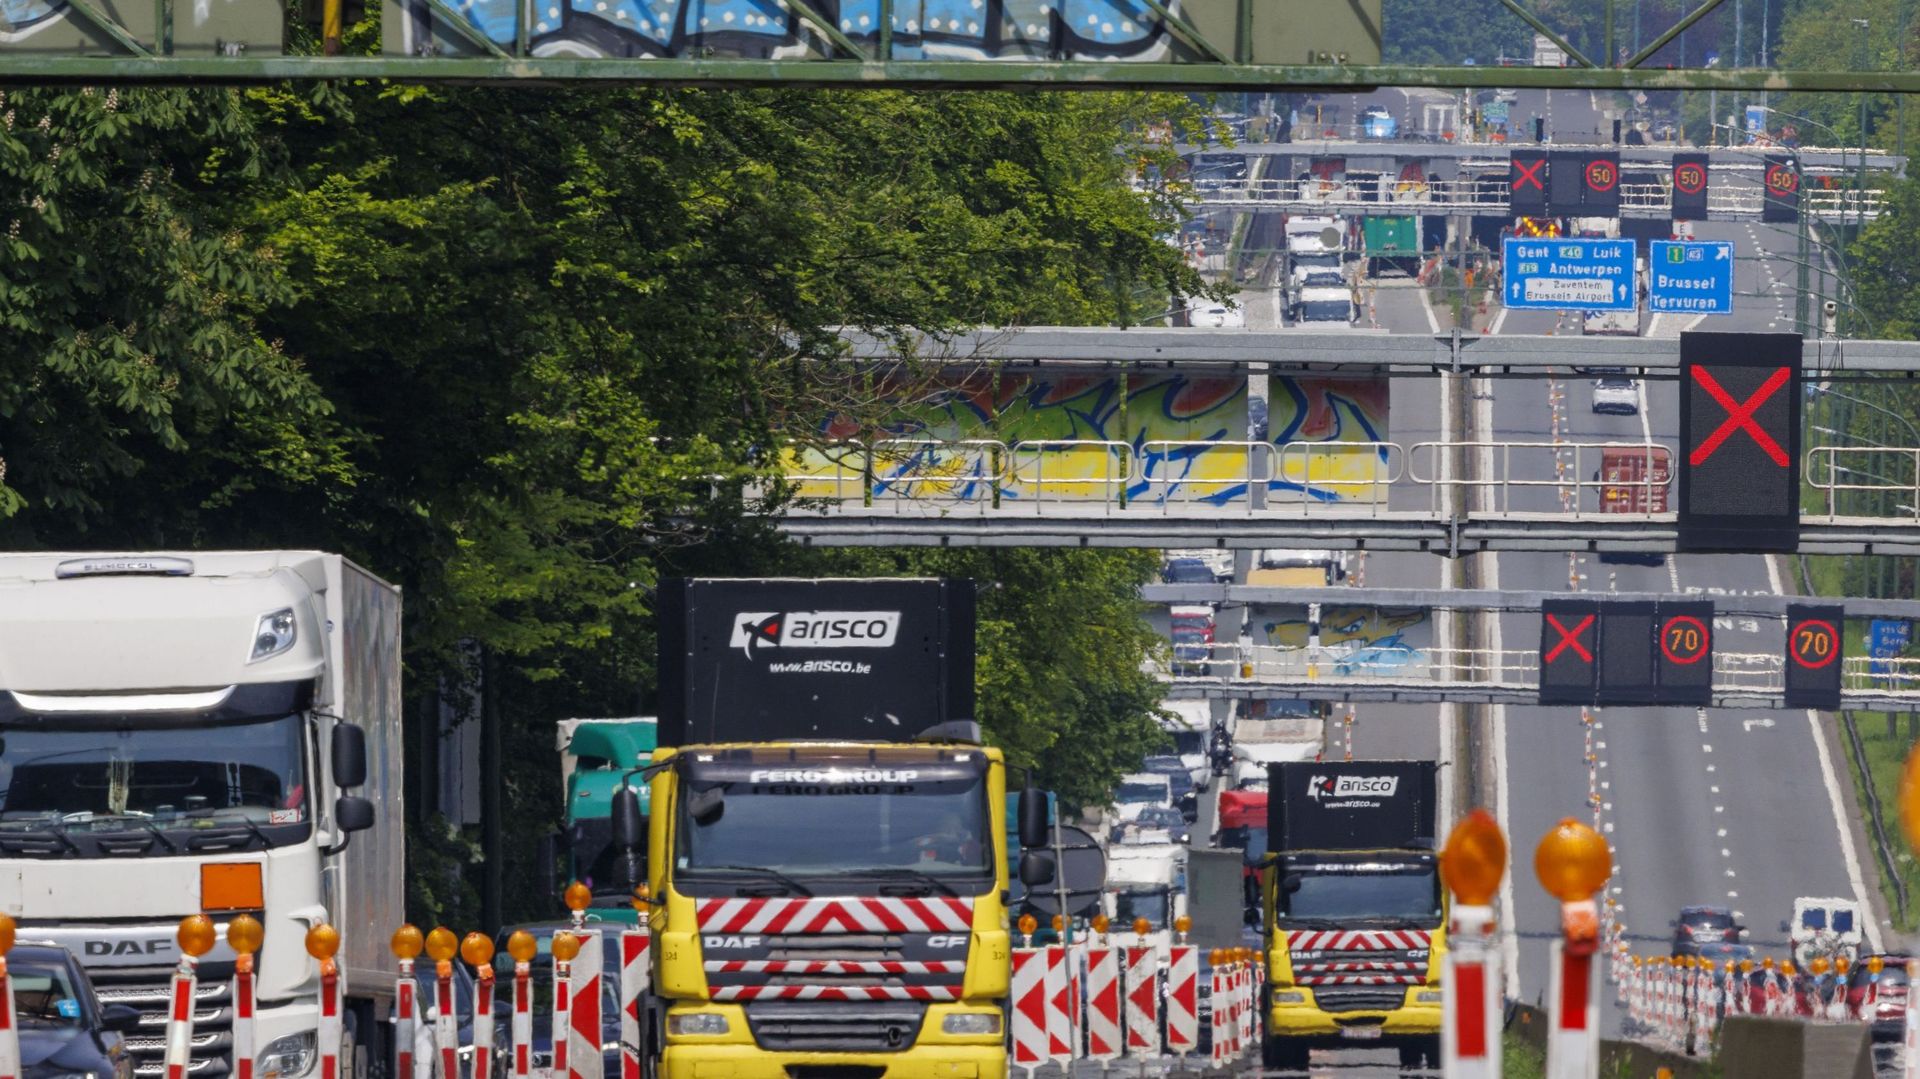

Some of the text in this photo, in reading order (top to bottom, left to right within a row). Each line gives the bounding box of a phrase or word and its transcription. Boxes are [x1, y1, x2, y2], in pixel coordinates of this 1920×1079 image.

[1592, 168, 1610, 183] 50
[1681, 170, 1699, 185] 50
[1772, 173, 1792, 187] 50
[1517, 246, 1621, 258] Gent E40 Luik
[1549, 263, 1622, 277] Antwerpen
[1553, 280, 1603, 289] Zaventem
[1658, 274, 1716, 289] Brussel
[1576, 292, 1612, 302] Airport
[1653, 294, 1717, 309] Tervuren
[790, 619, 888, 639] arisco
[1671, 629, 1698, 651] 70
[1801, 631, 1829, 656] 70
[769, 660, 872, 674] www.arisco.be
[1341, 780, 1392, 792] arisco
[84, 939, 172, 955] DAF
[704, 936, 968, 948] DAF CF
[1291, 950, 1429, 960] DAF CF
